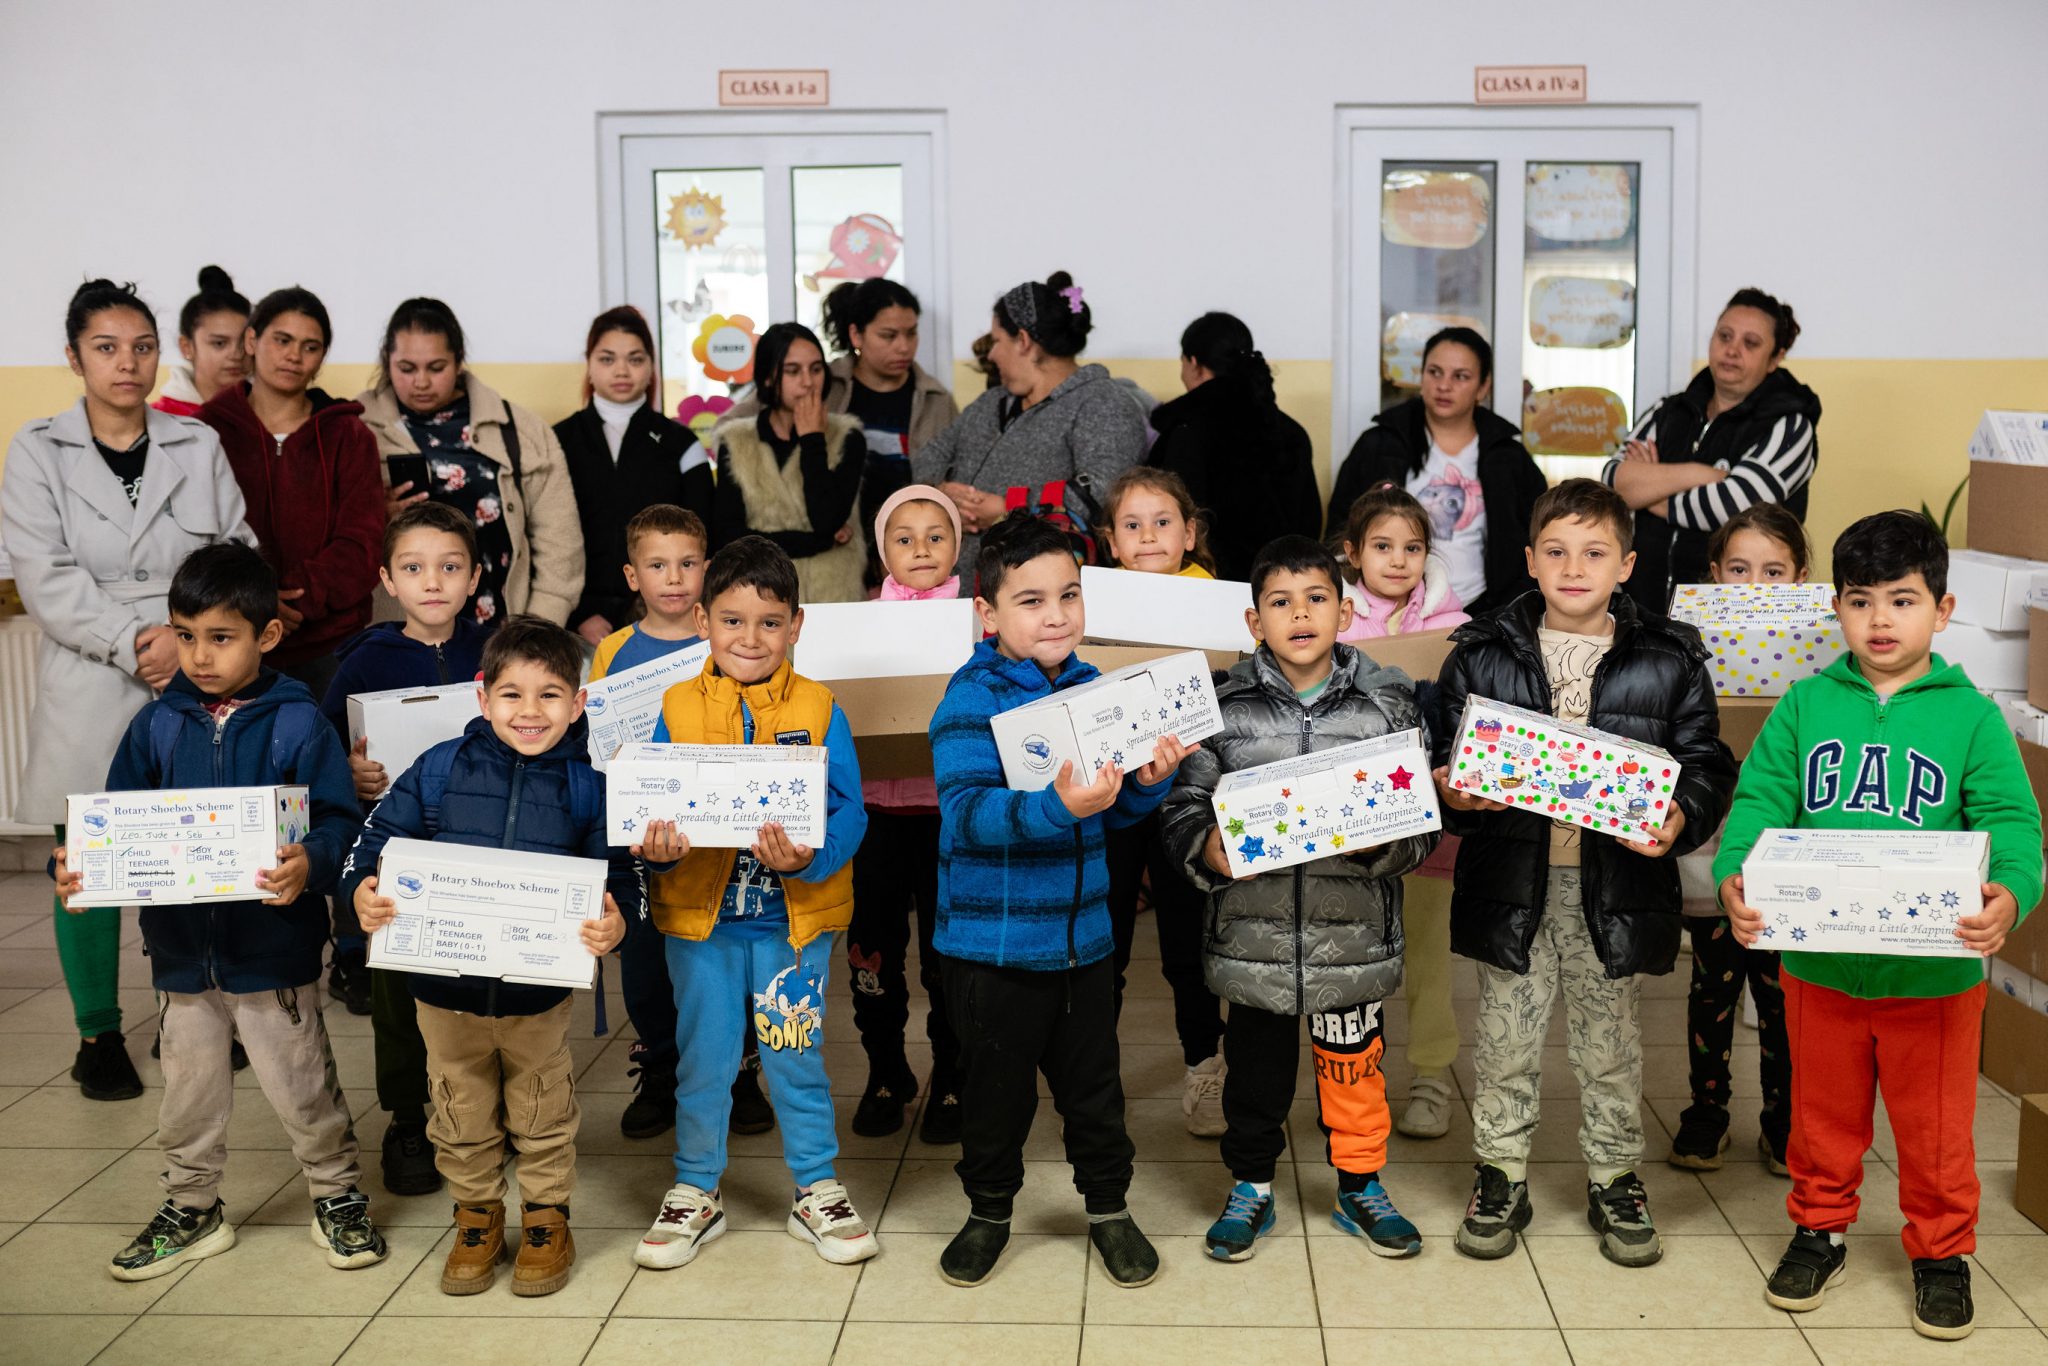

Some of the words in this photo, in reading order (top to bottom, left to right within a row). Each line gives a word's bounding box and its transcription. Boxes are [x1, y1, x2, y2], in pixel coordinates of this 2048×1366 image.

[731, 80, 779, 96] CLASA
[785, 83, 794, 95] a
[798, 80, 817, 95] I-a
[1482, 77, 1531, 92] CLASA
[1537, 80, 1546, 91] a
[1551, 76, 1579, 91] IV-a
[607, 677, 635, 694] Rotary
[636, 667, 671, 683] Shoebox
[672, 653, 704, 669] Scheme
[628, 712, 649, 723] CHILD
[1095, 714, 1113, 724] Rotary
[632, 717, 659, 731] TEENAG
[1126, 729, 1157, 749] Spreading
[1163, 717, 1180, 734] Little
[1180, 707, 1212, 729] Happiness
[1177, 718, 1214, 736] rotaryshoebox.org
[634, 729, 652, 739] BABY
[1500, 740, 1518, 750] otary
[640, 782, 665, 790] Rotary
[1804, 738, 1947, 827] GAP
[114, 806, 148, 817] Rotary
[151, 804, 193, 814] Shoebox
[196, 802, 235, 812] Scheme
[1248, 808, 1273, 819] Rotary
[674, 812, 721, 825] Spreading
[732, 811, 760, 822] Little
[761, 811, 812, 824] Happiness
[1289, 826, 1335, 845] Spreading
[1336, 824, 1342, 832] a
[1345, 814, 1372, 830] Little
[1373, 805, 1422, 823] Happiness
[1348, 816, 1425, 839] www.rotaryshoebox.org
[129, 859, 170, 867] TEENAGER
[127, 879, 176, 888] HOUSEHOLD
[431, 873, 468, 888] Rotary
[470, 877, 516, 890] Shoebox
[519, 882, 560, 894] Scheme
[1779, 889, 1805, 898] Rotary
[438, 919, 464, 928] CHILD
[438, 929, 483, 941] TEENAGER
[512, 926, 530, 934] BOY
[1815, 921, 1866, 934] Spreading
[1869, 925, 1876, 933] a
[1879, 923, 1909, 934] Little
[1911, 924, 1957, 939] Happine
[436, 940, 459, 948] BABY
[511, 934, 530, 942] GIRL
[1880, 936, 1966, 944] www.rotaryshoebox.or
[434, 950, 487, 962] HOUSEHOLD
[753, 1011, 814, 1055] SONIC
